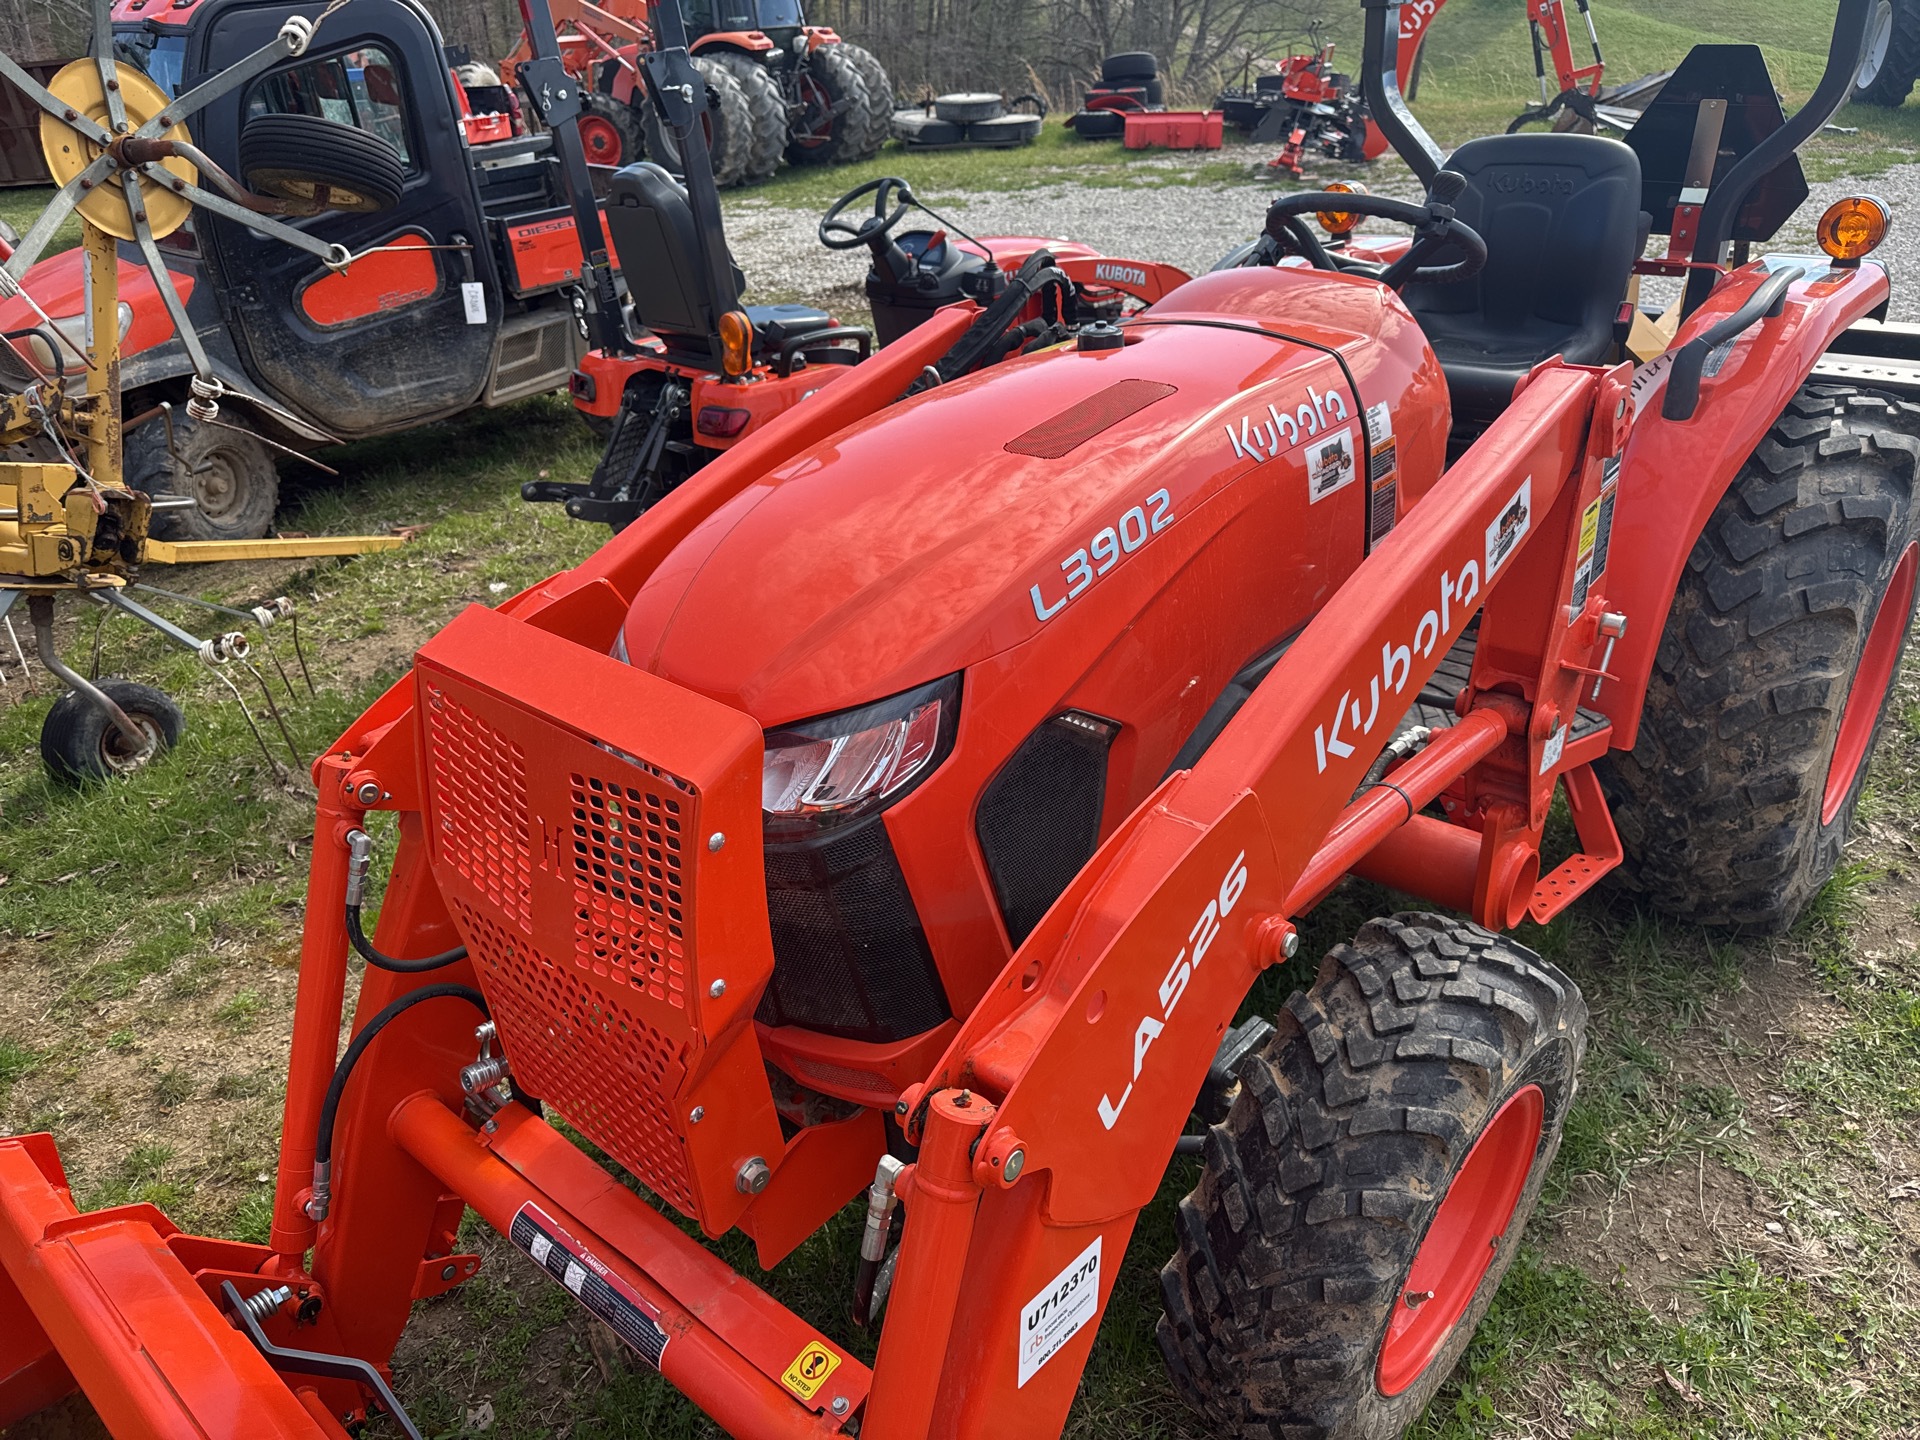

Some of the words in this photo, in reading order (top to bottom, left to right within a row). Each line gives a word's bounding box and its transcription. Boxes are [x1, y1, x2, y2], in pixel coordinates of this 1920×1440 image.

[1487, 171, 1574, 195] Kubota
[518, 221, 575, 237] DIESEL
[1095, 264, 1146, 286] KUBOTA
[1224, 386, 1348, 463] Kubota
[1029, 487, 1175, 622] L3902
[1315, 559, 1479, 774] Kubota
[1097, 849, 1247, 1130] LA526
[585, 1255, 609, 1277] DANGER
[1028, 1254, 1098, 1331] U712370
[1029, 1334, 1044, 1354] rb
[788, 1373, 798, 1383] NO
[796, 1380, 811, 1392] STEP
